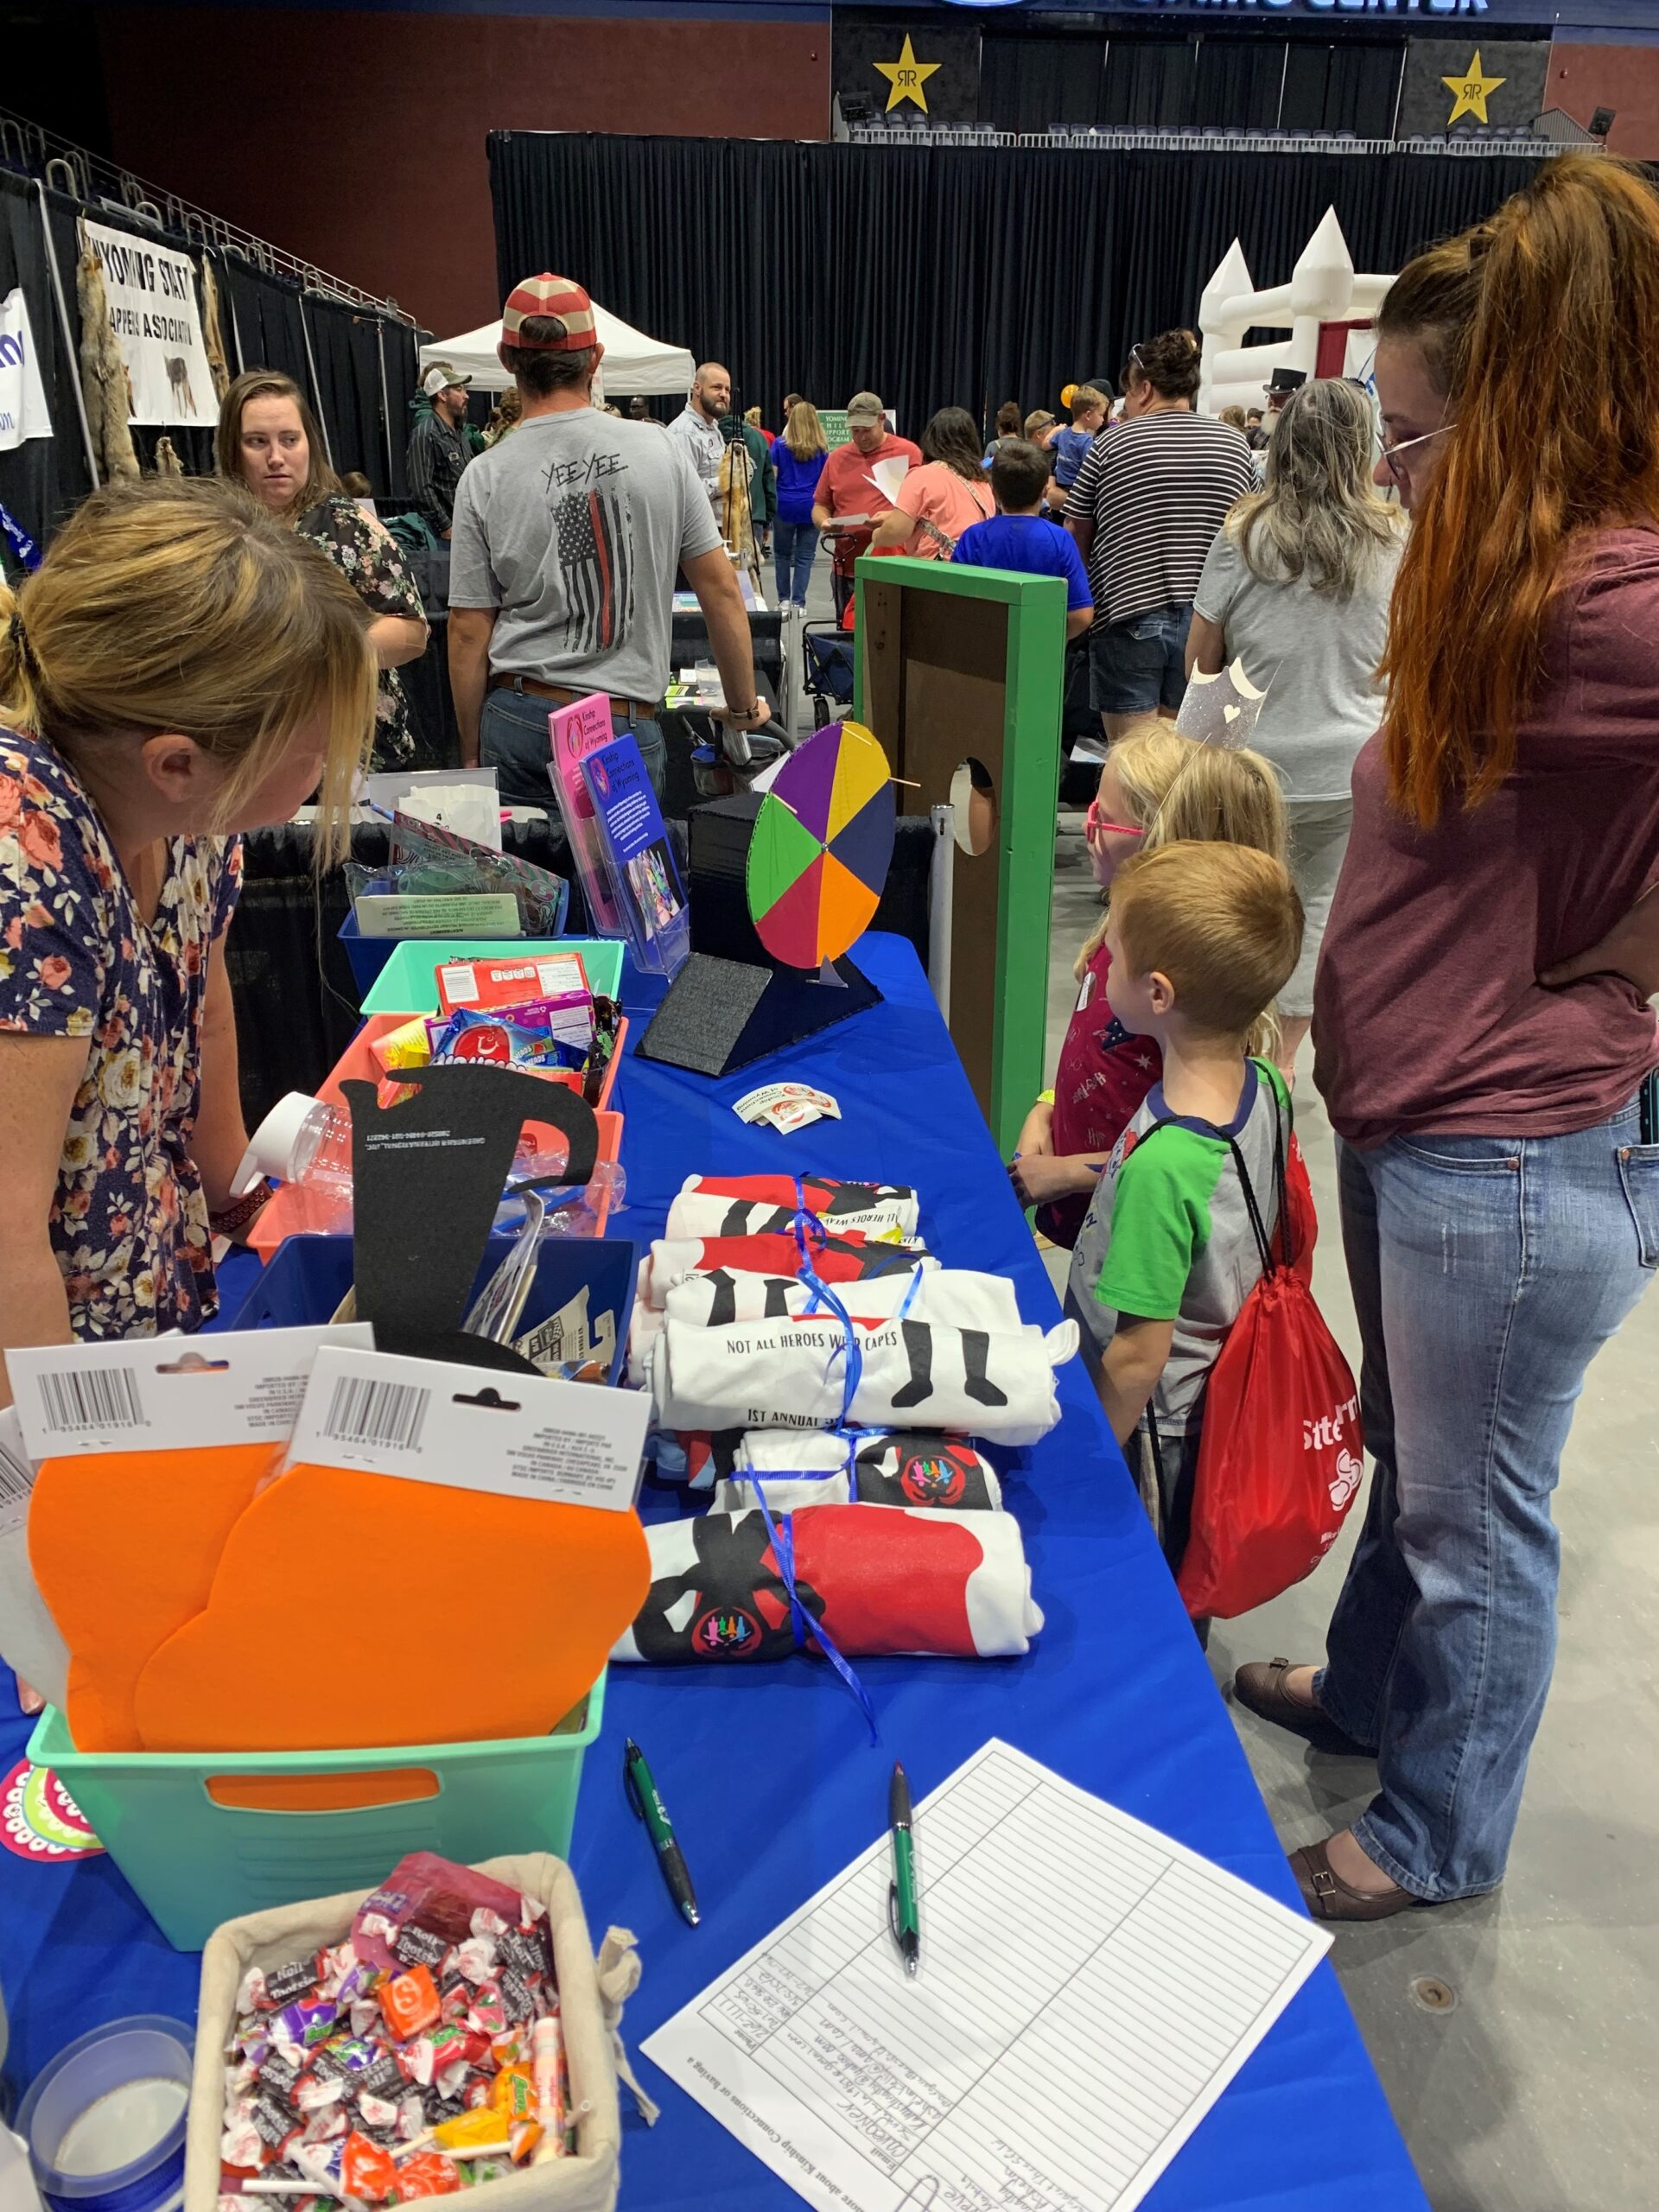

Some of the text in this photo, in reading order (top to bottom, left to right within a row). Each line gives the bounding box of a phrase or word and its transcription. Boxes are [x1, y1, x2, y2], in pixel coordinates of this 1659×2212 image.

[541, 453, 629, 494] YEE YEE
[727, 1339, 751, 1354] NOT
[756, 1338, 777, 1351] ALL
[780, 1333, 825, 1348] HEROES
[865, 1332, 898, 1351] CAPES
[686, 2055, 695, 2065] a
[691, 2060, 724, 2091] having
[719, 2085, 732, 2099] or
[727, 2093, 784, 2146] Connections
[777, 2138, 818, 2176] Kinship
[870, 2145, 898, 2172] Email
[813, 2170, 843, 2199] about
